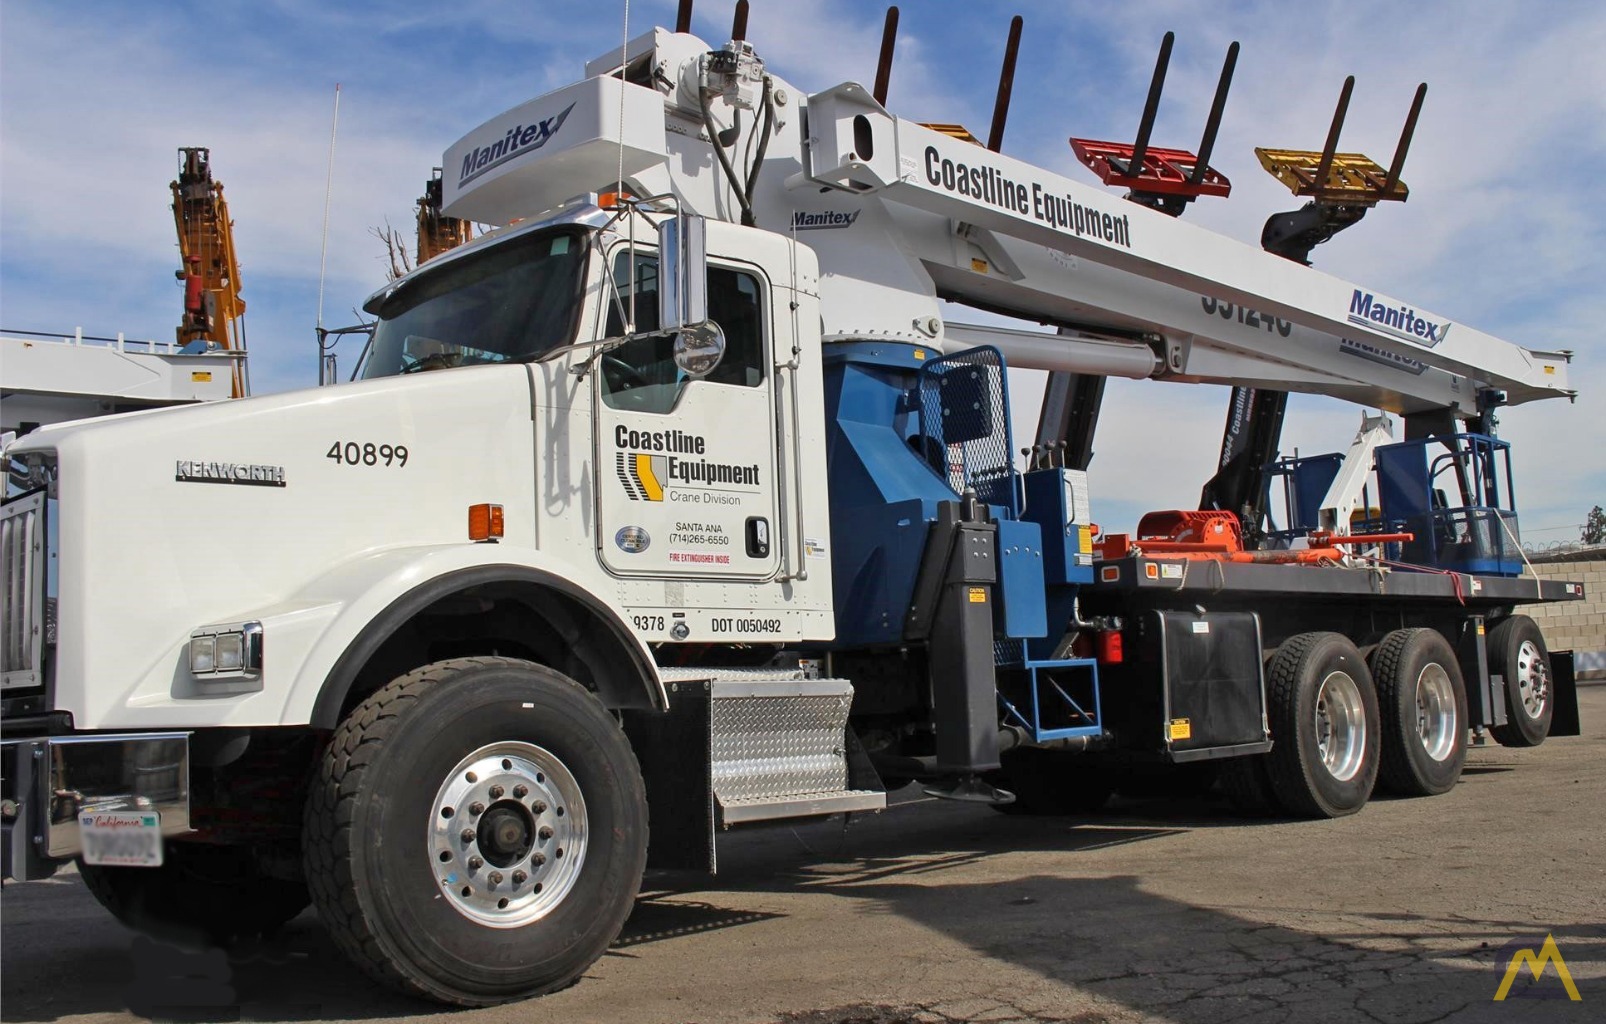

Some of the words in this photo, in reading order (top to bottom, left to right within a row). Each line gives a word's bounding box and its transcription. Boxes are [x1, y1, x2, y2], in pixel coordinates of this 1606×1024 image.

[460, 116, 555, 180] Manitex
[924, 145, 1029, 215] Coastline
[1031, 182, 1131, 248] Equipment
[790, 211, 851, 226] Manitex
[1349, 289, 1439, 341] Manitex
[615, 424, 705, 455] Coastline
[326, 441, 409, 468] 40899
[176, 460, 285, 482] KENWORTH
[668, 456, 760, 486] Equipment
[669, 490, 700, 503] Crane
[703, 492, 741, 506] Division
[675, 521, 704, 532] SANTA
[705, 524, 723, 533] ANA
[669, 533, 729, 545] (714)265-6550
[669, 553, 680, 562] FIRE
[681, 553, 714, 563] EXTINGUISHER
[715, 555, 730, 564] INSIDE
[629, 615, 665, 631] 9378
[711, 618, 734, 632] DOT
[736, 619, 782, 633] 0050492
[95, 815, 142, 829] California
